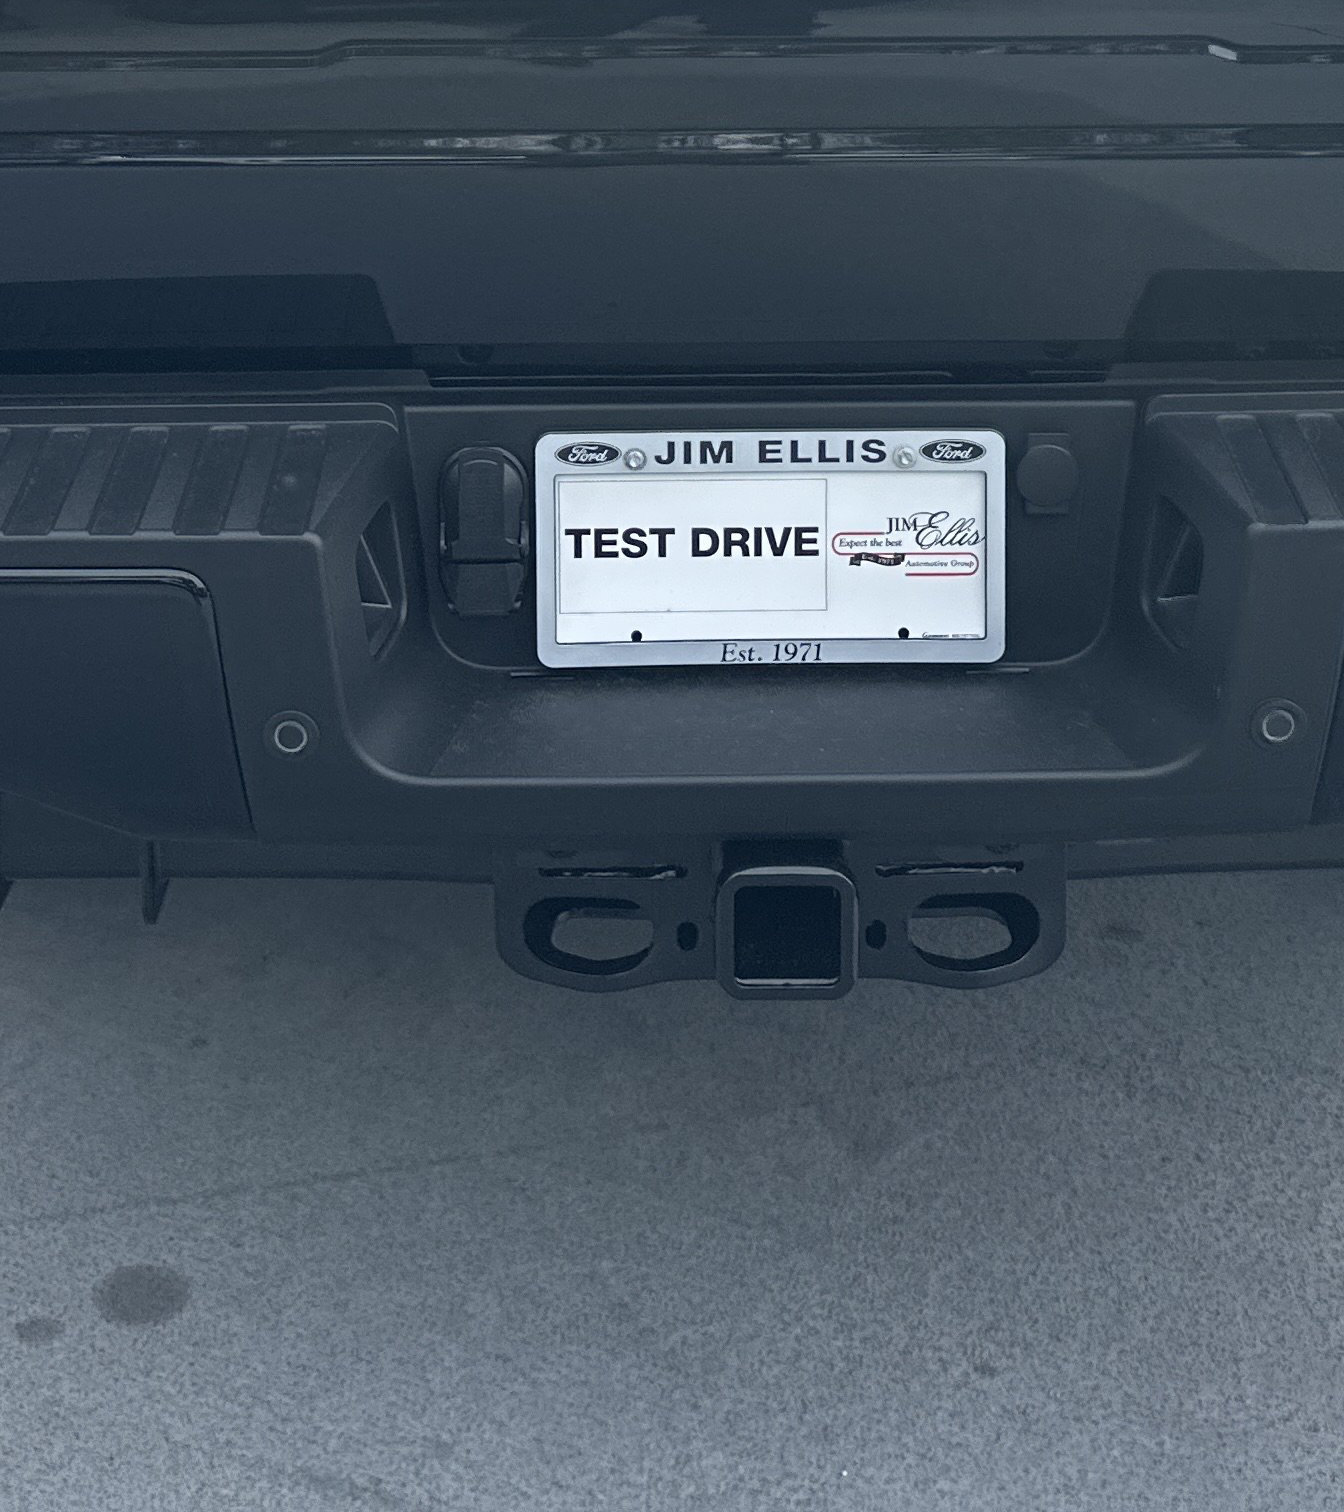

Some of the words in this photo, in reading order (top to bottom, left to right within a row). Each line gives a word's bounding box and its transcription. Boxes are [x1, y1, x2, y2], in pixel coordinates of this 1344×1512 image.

[568, 445, 608, 463] Ford
[654, 440, 733, 465] JIM
[758, 439, 887, 464] ELLIS
[932, 442, 974, 460] Ford
[885, 516, 918, 535] JIM
[908, 510, 986, 550] Ellis
[564, 527, 676, 559] TEST
[691, 526, 820, 558] DRIVE
[839, 538, 868, 549] Expect
[870, 537, 883, 547] the
[885, 537, 903, 547] best
[950, 559, 975, 568] Group
[720, 642, 763, 663] Est.
[772, 642, 823, 662] 1971
